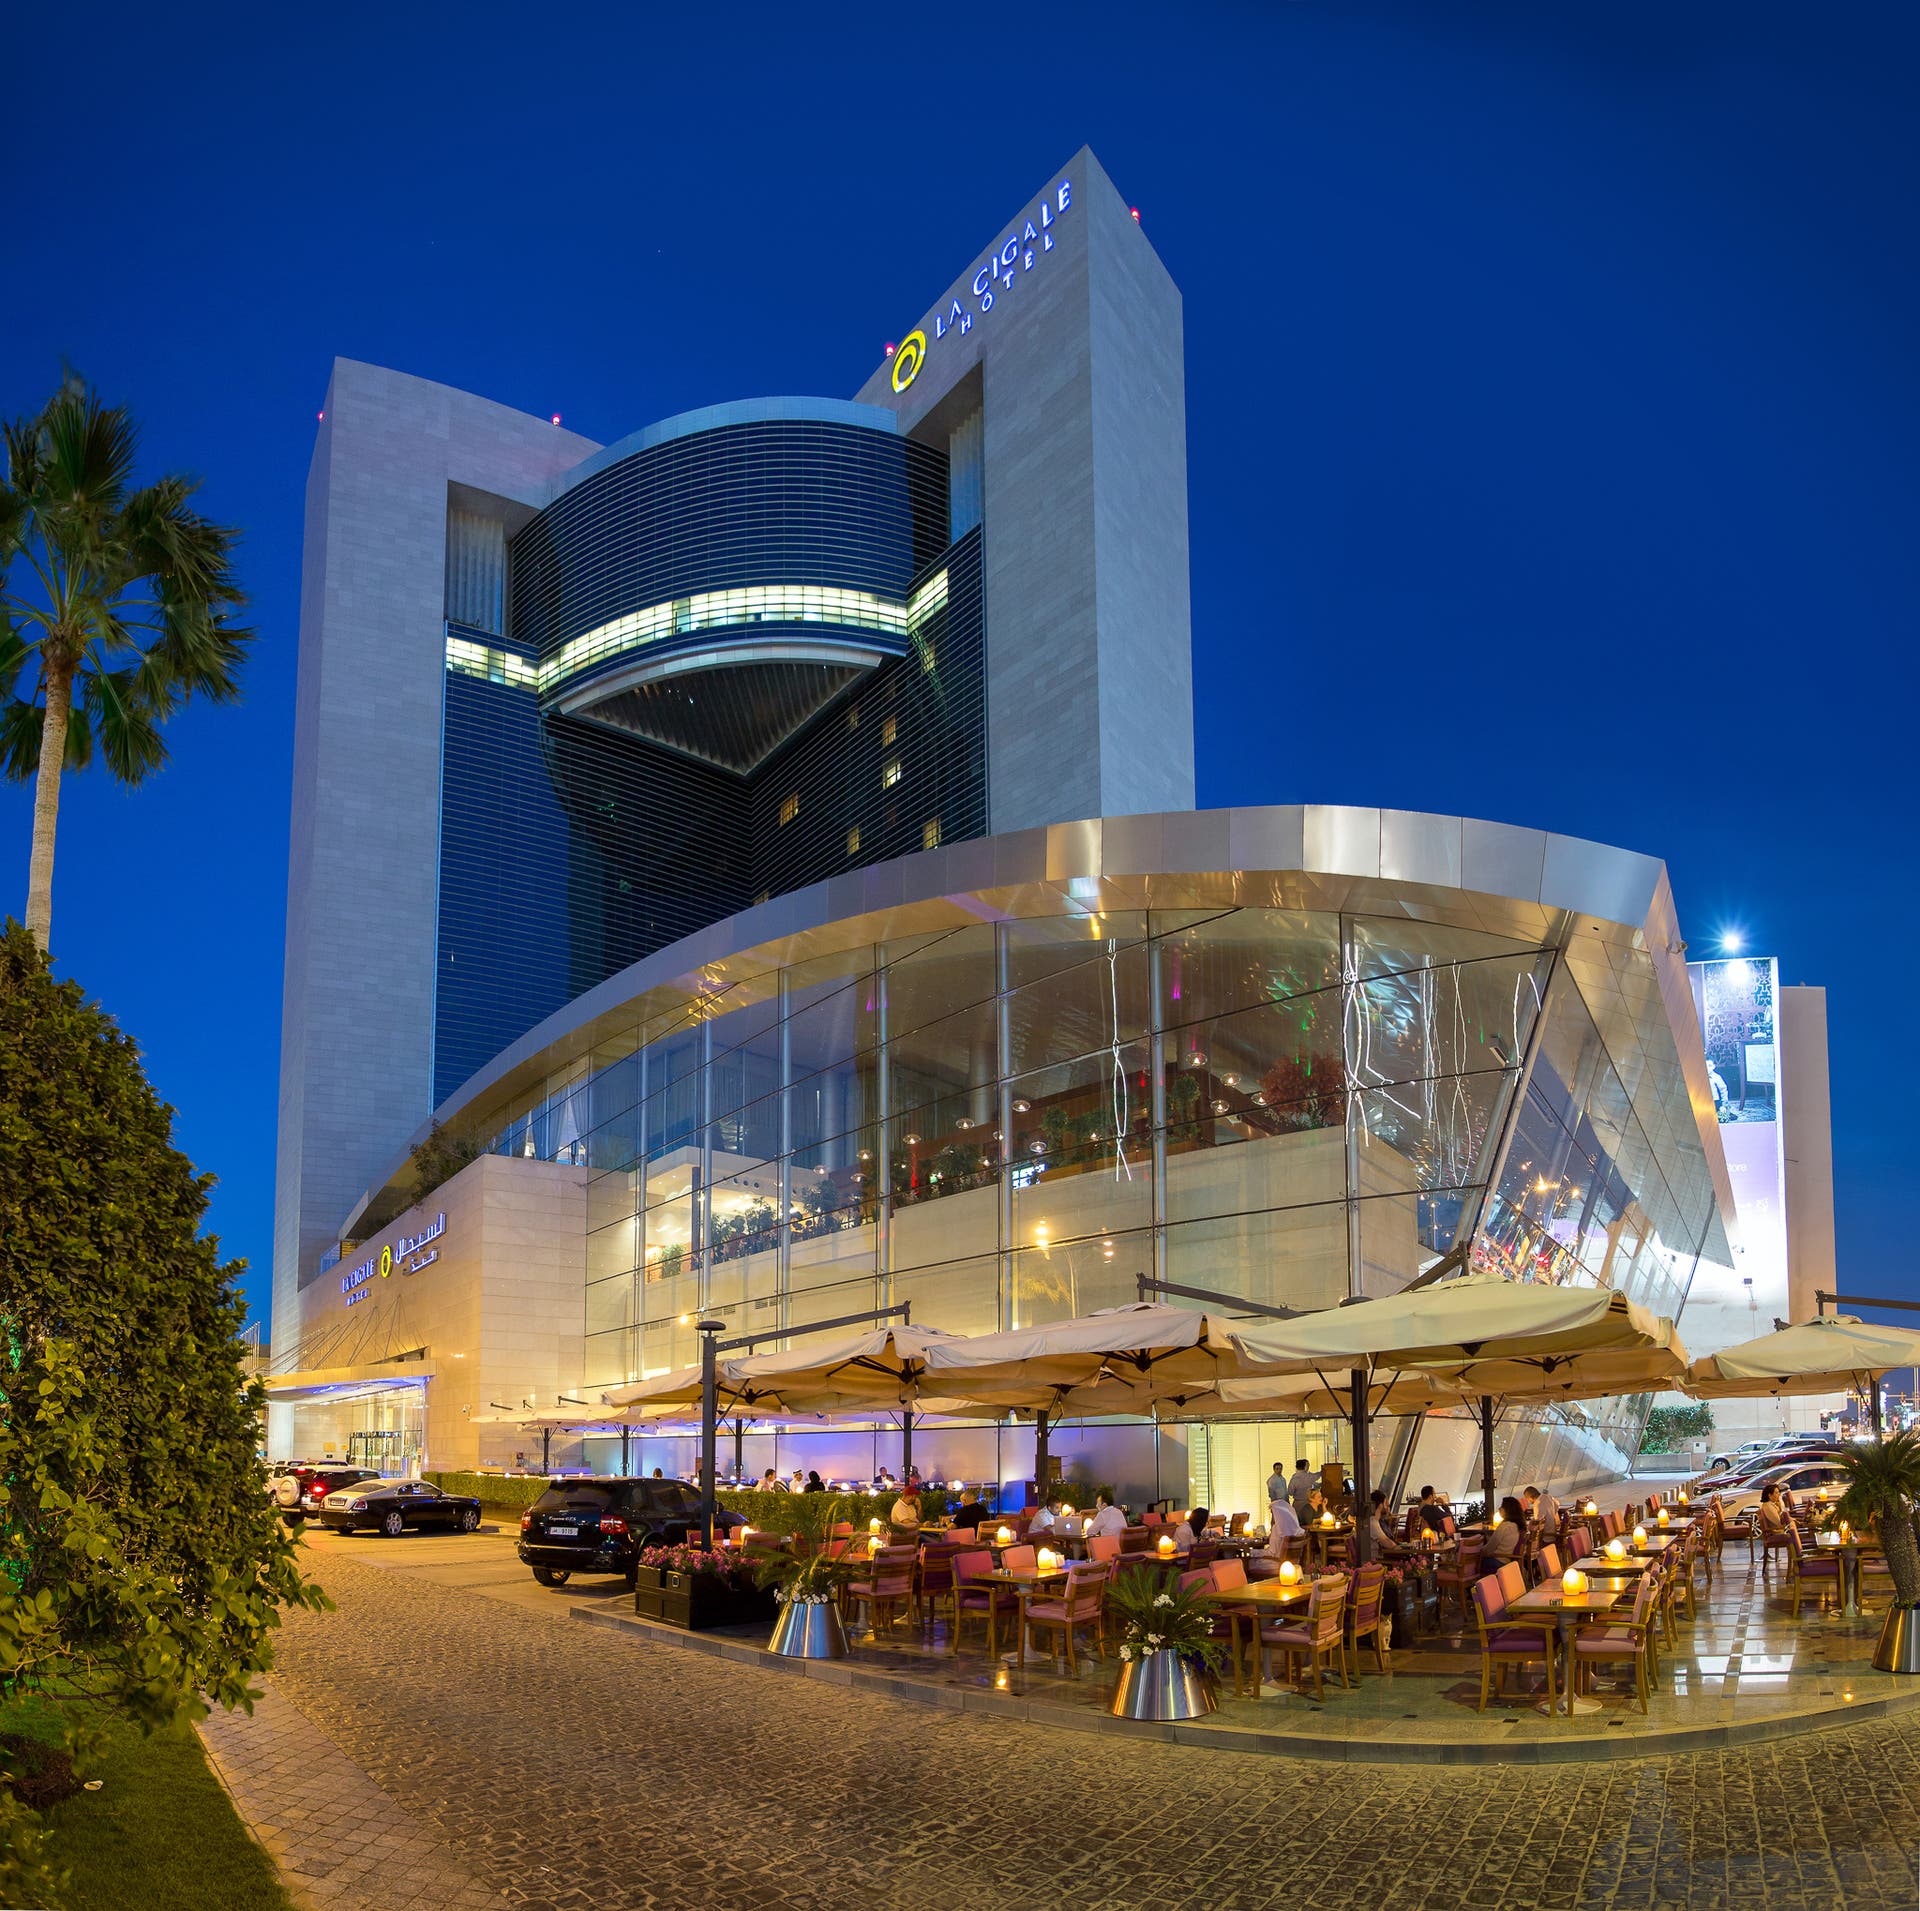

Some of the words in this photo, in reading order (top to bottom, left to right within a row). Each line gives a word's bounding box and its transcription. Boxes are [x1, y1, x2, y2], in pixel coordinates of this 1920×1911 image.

[935, 299, 963, 339] LA
[972, 180, 1072, 297] CIGALE
[959, 232, 1054, 335] HOTEL
